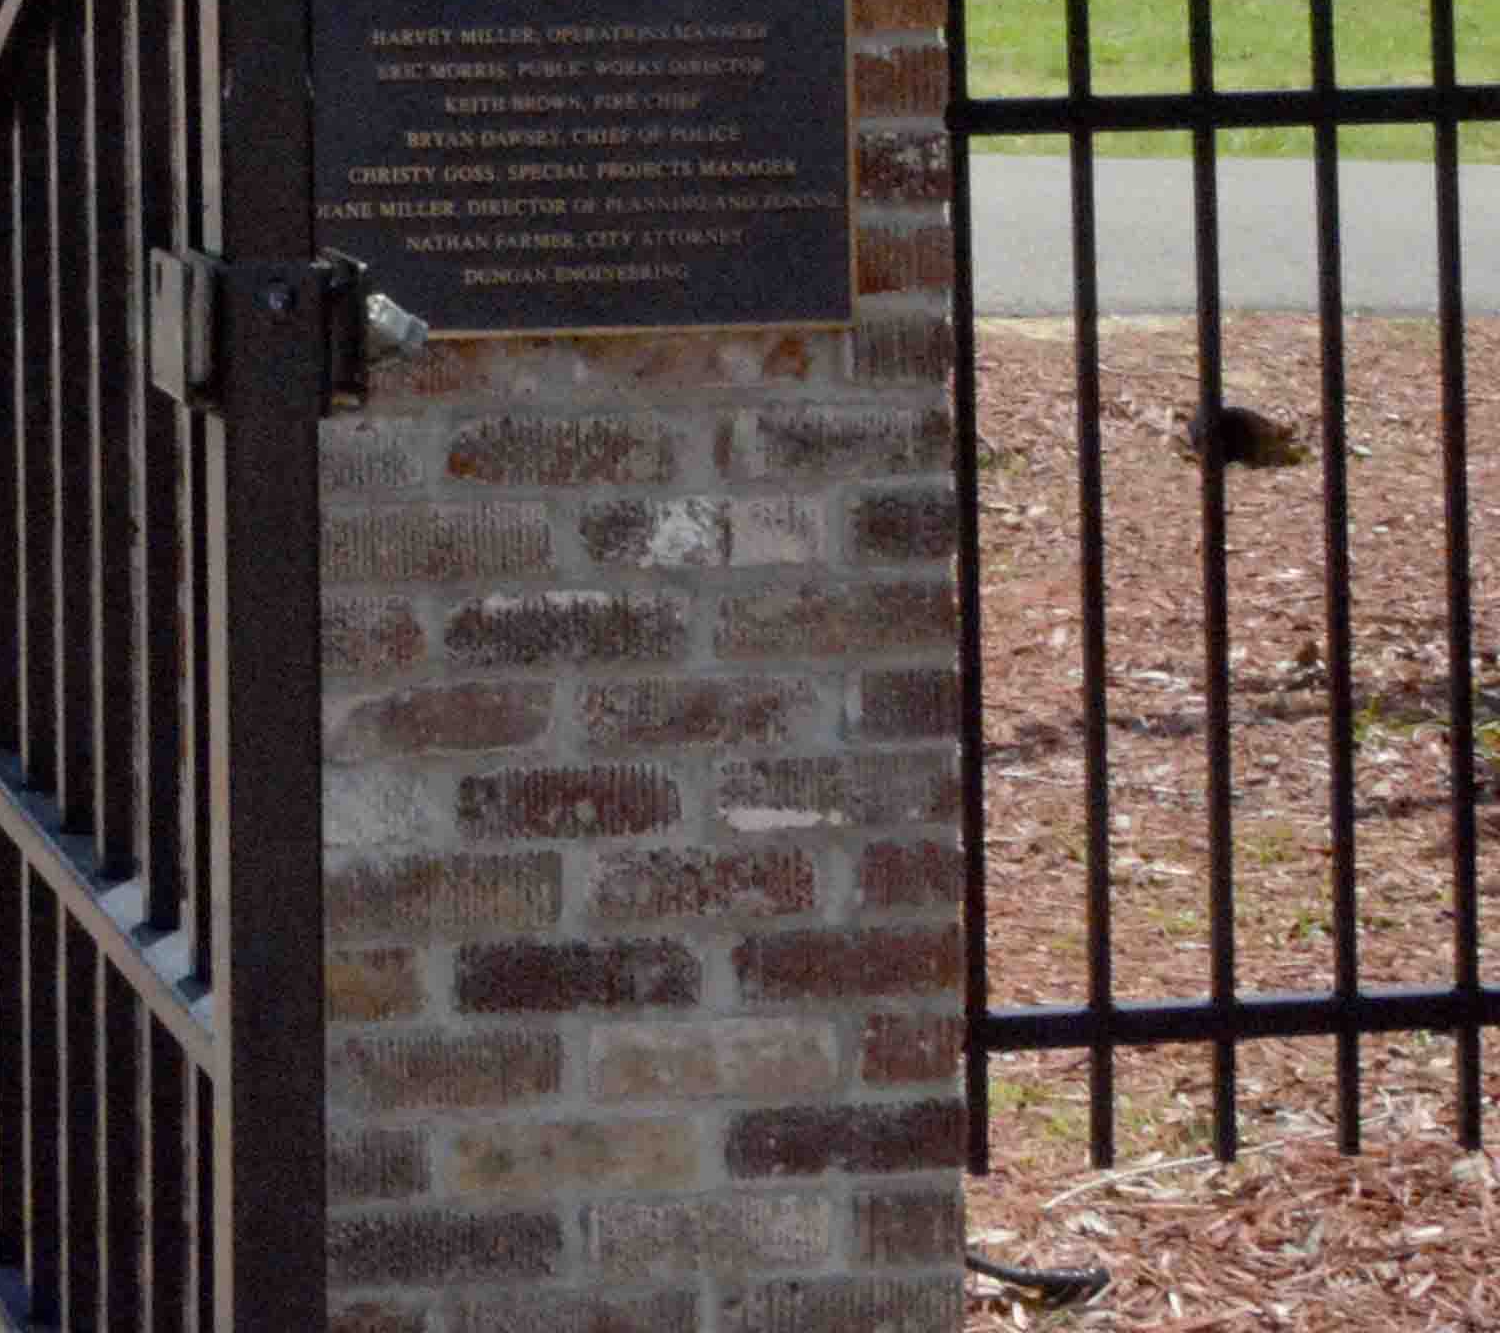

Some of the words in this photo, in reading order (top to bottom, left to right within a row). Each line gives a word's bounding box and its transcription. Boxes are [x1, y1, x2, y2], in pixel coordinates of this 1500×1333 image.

[372, 28, 454, 46] HARVEY
[444, 96, 507, 114] KEITH
[406, 130, 475, 149] BRYAN
[347, 165, 437, 186] CHRISTY
[506, 162, 588, 183] SPECIAL
[596, 160, 694, 180] PROJECTS
[699, 157, 798, 177] MANAGER
[467, 197, 567, 218] DIRECTOR
[405, 234, 489, 252] NATHAN
[586, 230, 634, 249] CITY
[554, 263, 690, 284] ENGINEERING
